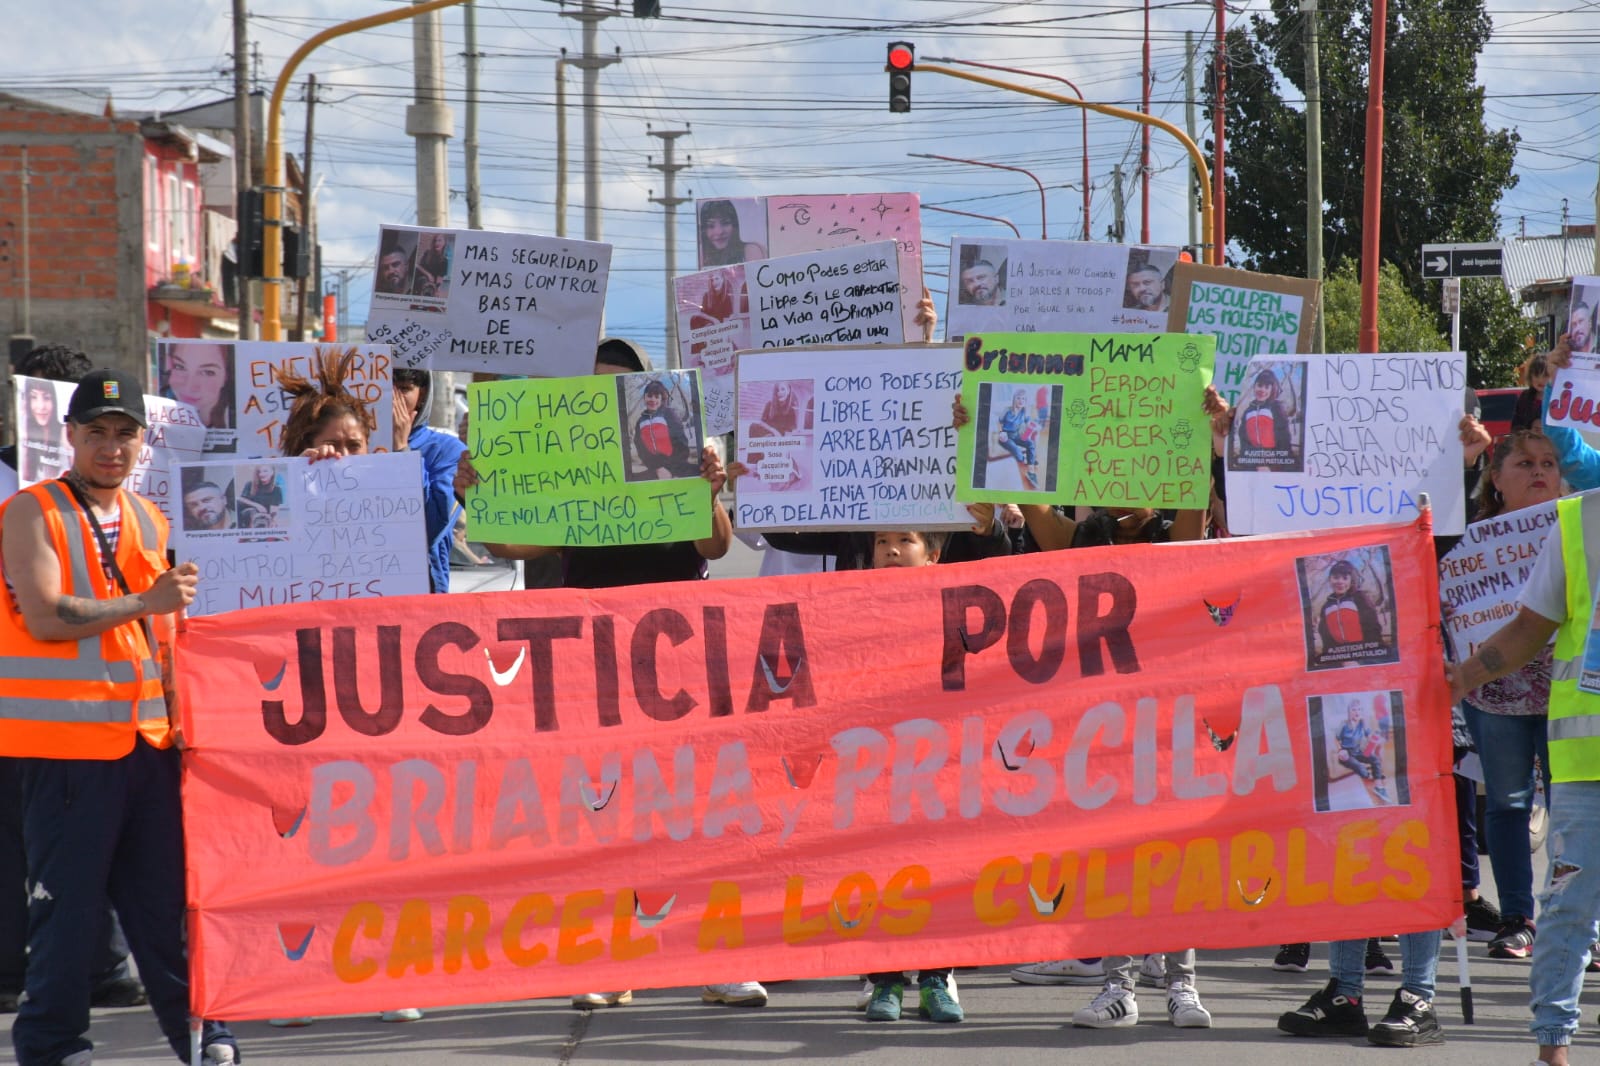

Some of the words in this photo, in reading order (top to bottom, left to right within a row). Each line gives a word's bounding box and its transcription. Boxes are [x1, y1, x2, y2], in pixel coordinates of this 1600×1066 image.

[464, 245, 499, 262] MAS
[512, 248, 599, 273] SEGURIDAD
[525, 273, 600, 293] CONTROL
[479, 296, 537, 313] BASTA
[1191, 283, 1282, 313] DISCULPEN
[486, 319, 510, 334] DE
[1187, 305, 1216, 326] LAS
[1220, 310, 1298, 336] MOLESTIAS
[450, 338, 535, 356] MUERTES
[824, 376, 872, 392] COMO
[1090, 366, 1176, 394] PERDON
[1324, 356, 1361, 392] NO
[1370, 357, 1465, 392] ESTAMOS
[476, 388, 526, 422] HOY
[537, 390, 608, 420] HAGO
[820, 400, 873, 423] LIBRE
[1316, 396, 1409, 423] TODAS
[569, 424, 619, 452] POR
[1085, 424, 1168, 449] SABER
[1310, 424, 1382, 452] FALTA
[302, 468, 359, 493] MAS
[304, 495, 422, 526] SEGURIDAD
[648, 492, 696, 518] TE
[739, 504, 776, 525] POR
[782, 502, 872, 522] DELANTE
[1274, 482, 1419, 518] JUSTICIA
[564, 518, 673, 545] AMAMOS
[1518, 511, 1559, 534] LUCH
[304, 528, 322, 552] Y
[332, 526, 386, 549] MAS
[318, 552, 402, 578] BASTA
[1446, 570, 1514, 609] BRIANNA
[262, 602, 818, 746] JUSTICIA
[940, 571, 1142, 692] POR
[308, 740, 764, 866] BRIANNA
[831, 684, 1298, 830] PRISCILA
[332, 888, 660, 983] CARCEL
[698, 880, 745, 952] A
[781, 864, 932, 945] LOS
[973, 819, 1432, 927] CULPABLES
